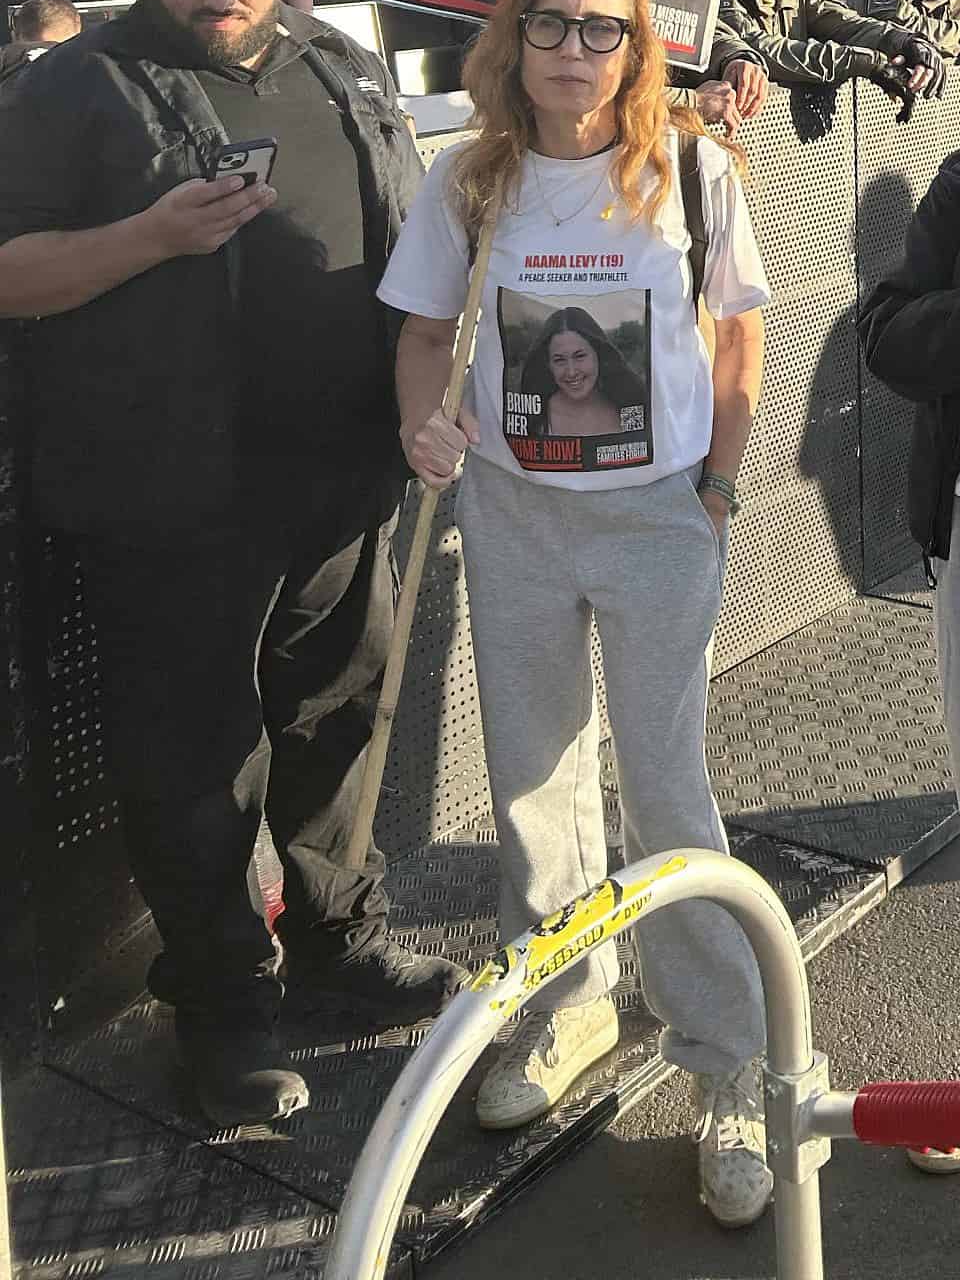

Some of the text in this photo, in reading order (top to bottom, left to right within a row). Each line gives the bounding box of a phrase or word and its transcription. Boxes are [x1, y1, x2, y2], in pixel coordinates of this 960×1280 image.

[656, 4, 699, 28] MISSING
[656, 20, 697, 48] ORUM
[524, 255, 567, 268] NAAMA
[569, 254, 598, 268] LEVY
[518, 272, 628, 282] A PEACE SEEKER AND TRIATHLETE
[507, 392, 541, 415] BRING
[506, 413, 528, 436] HER
[543, 438, 582, 462] NOW!
